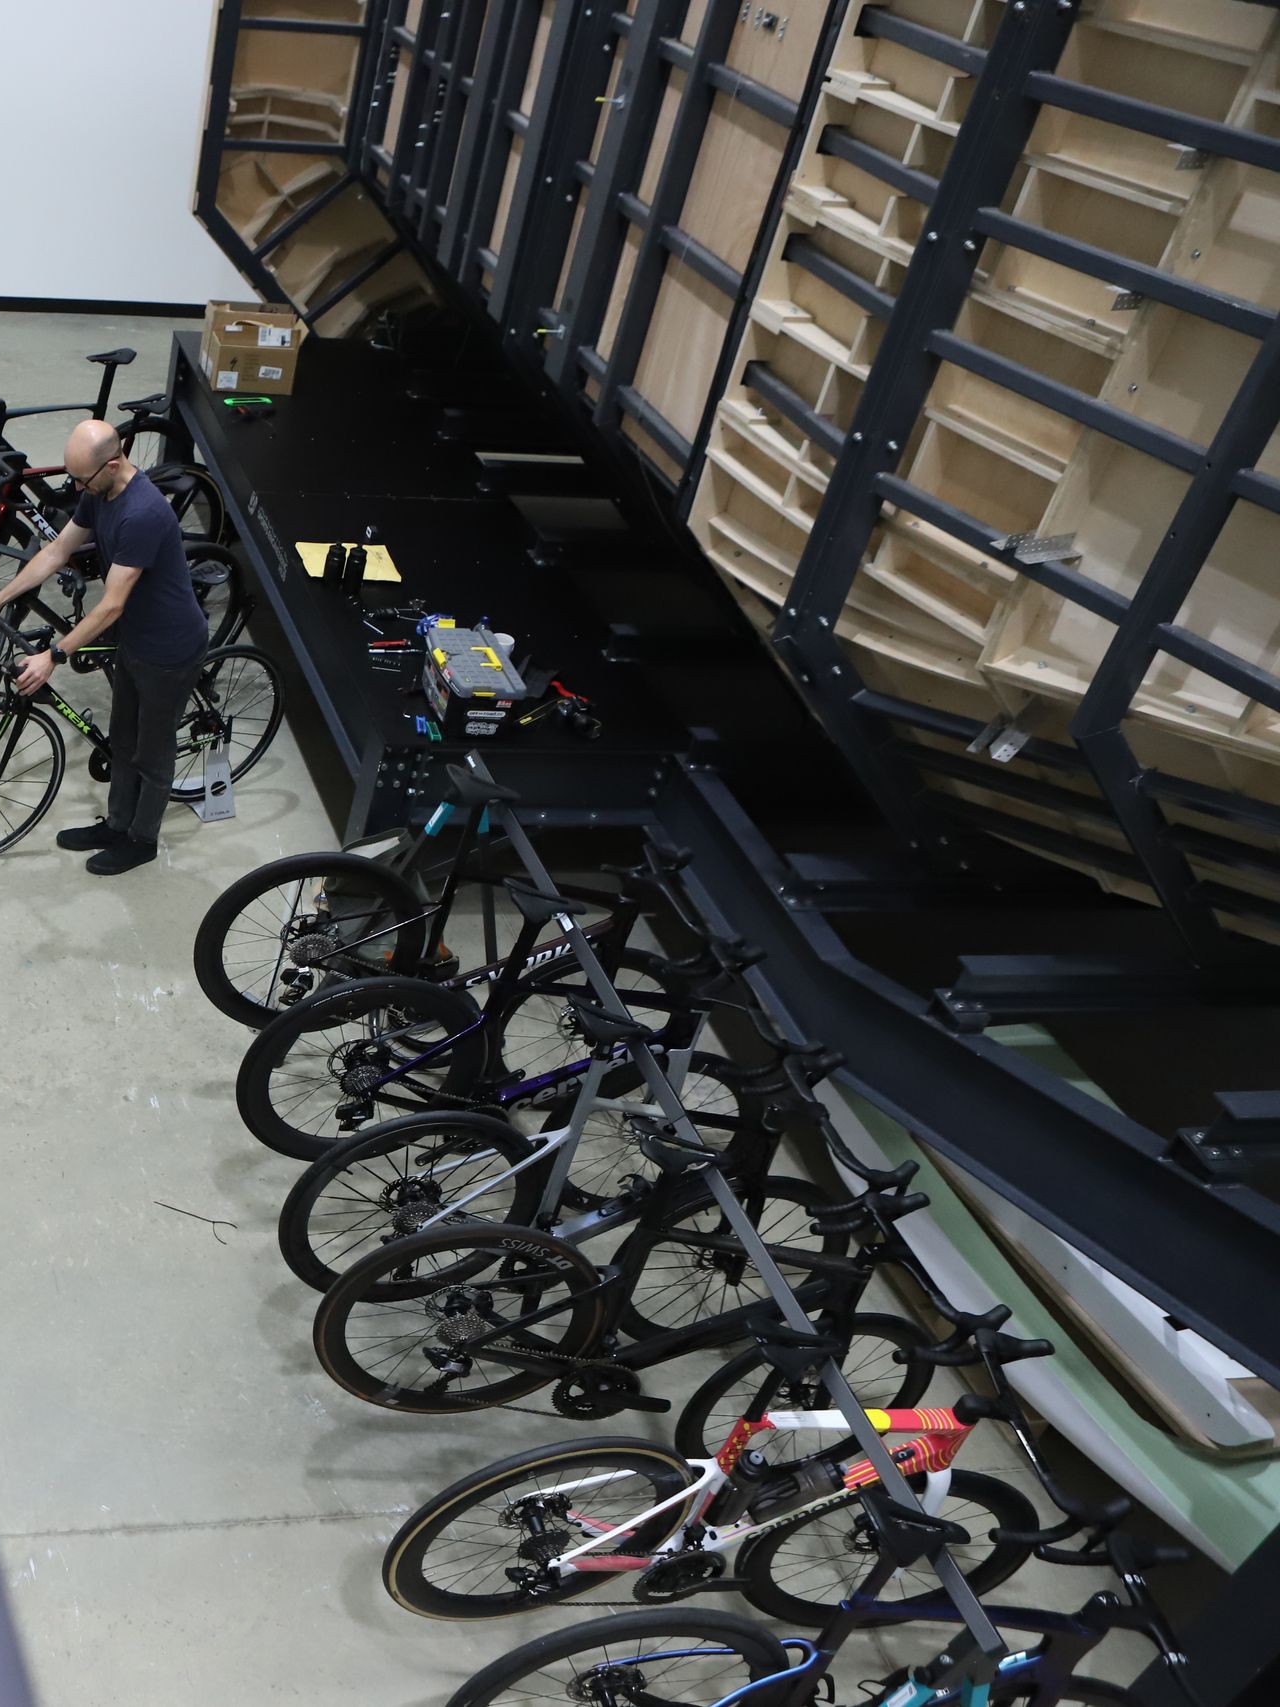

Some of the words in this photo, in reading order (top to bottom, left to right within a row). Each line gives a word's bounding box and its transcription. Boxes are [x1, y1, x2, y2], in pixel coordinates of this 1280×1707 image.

[24, 499, 60, 542] TRE
[51, 691, 91, 735] TREK
[498, 1237, 551, 1257] SWISS
